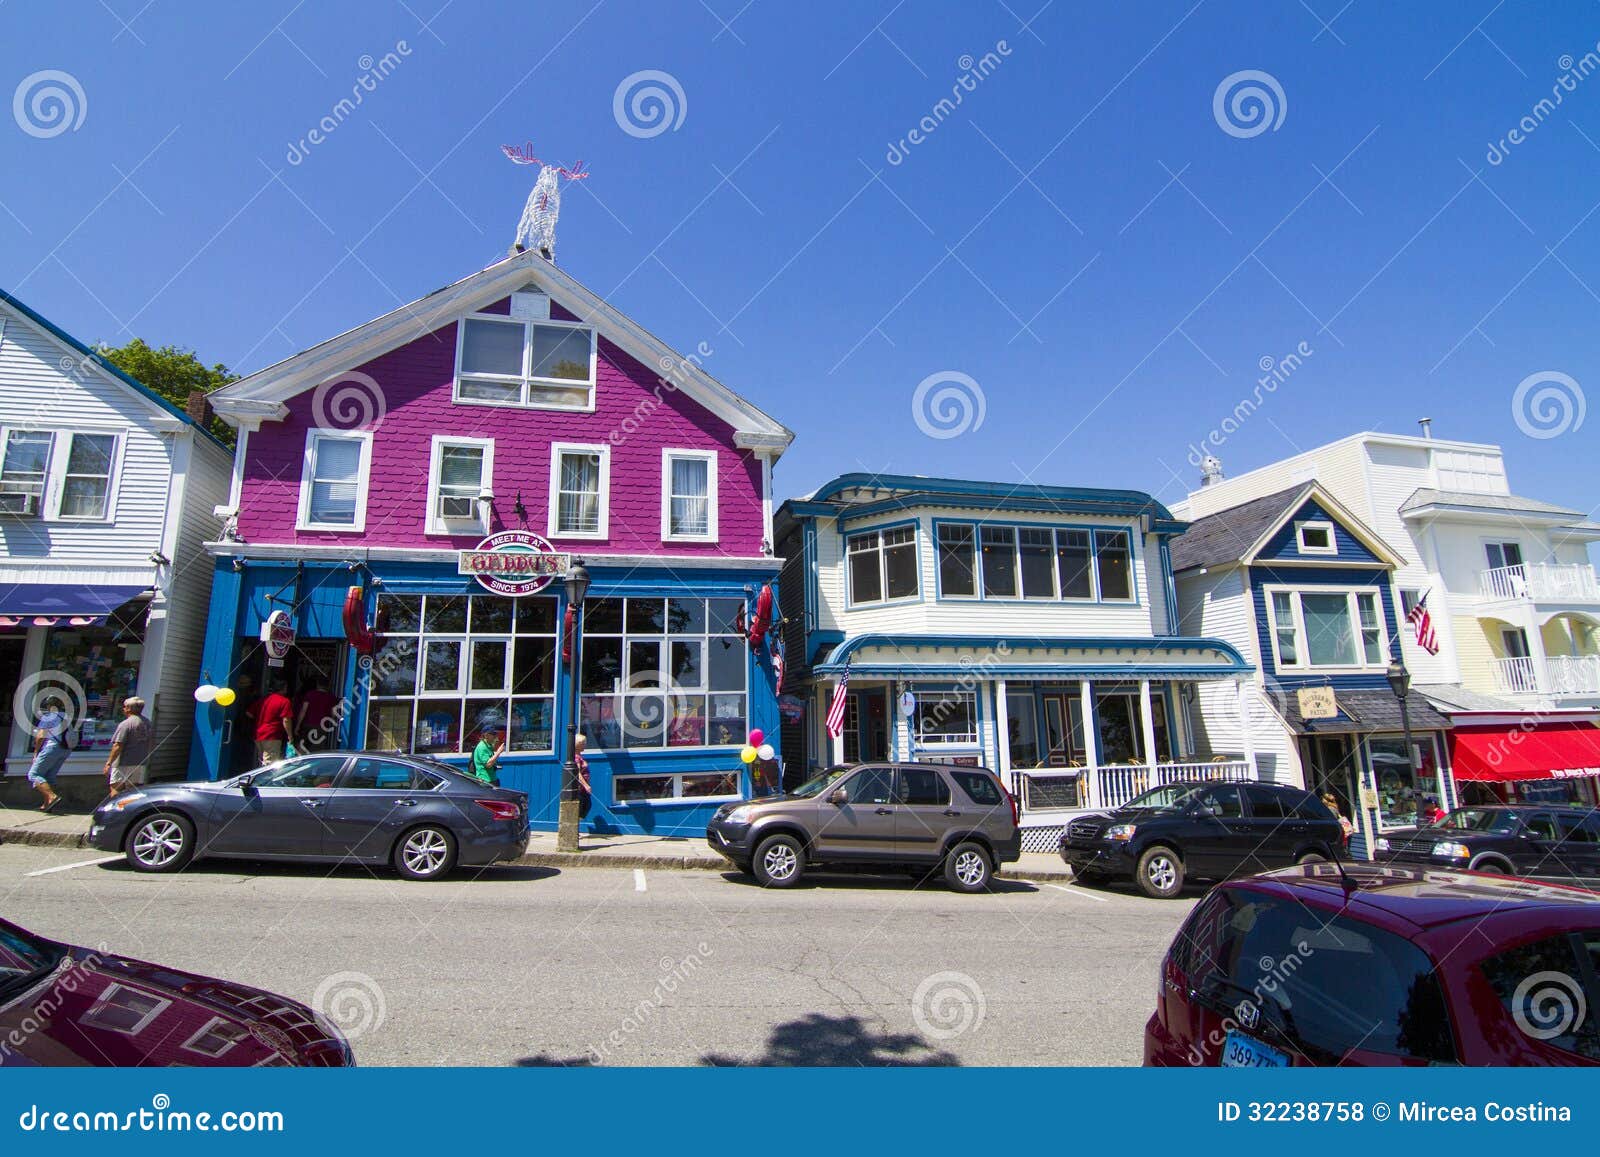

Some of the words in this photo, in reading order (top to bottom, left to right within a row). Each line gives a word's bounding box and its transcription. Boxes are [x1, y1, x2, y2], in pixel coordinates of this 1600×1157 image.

[491, 535, 514, 546] MEET
[516, 535, 530, 543] ME
[490, 580, 517, 592] SINCE
[521, 582, 539, 592] 1974
